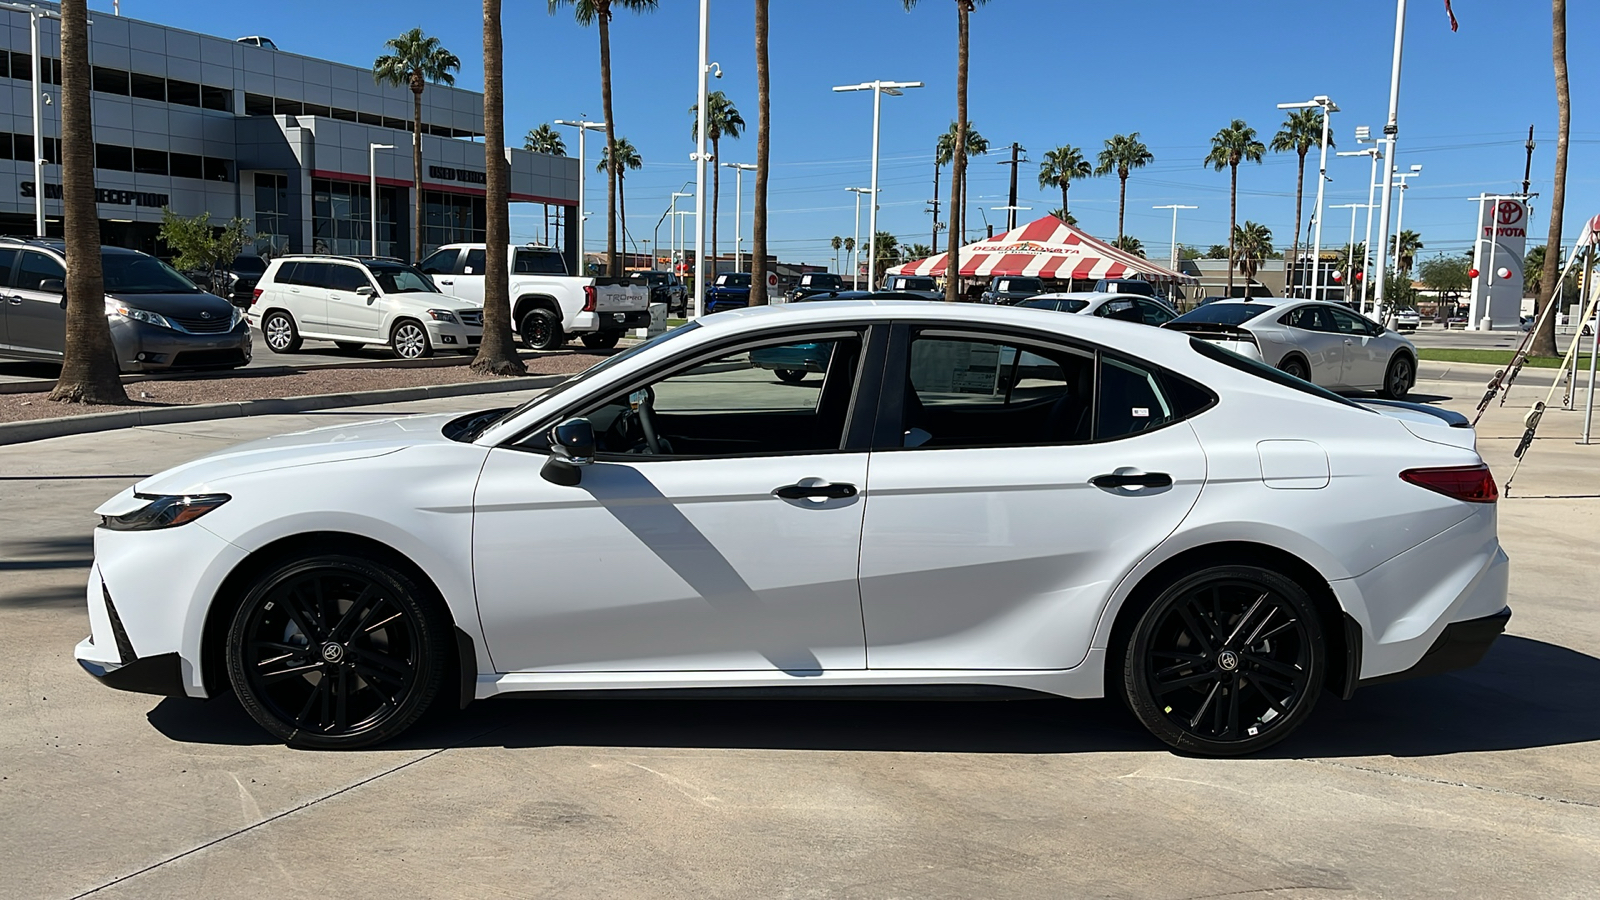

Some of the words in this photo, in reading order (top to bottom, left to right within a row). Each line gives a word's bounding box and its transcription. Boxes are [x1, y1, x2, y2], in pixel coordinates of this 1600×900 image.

[429, 166, 455, 180] USED
[456, 169, 486, 184] VEHIC
[1483, 226, 1526, 238] TOYOTA
[1027, 246, 1080, 254] TOYOTA
